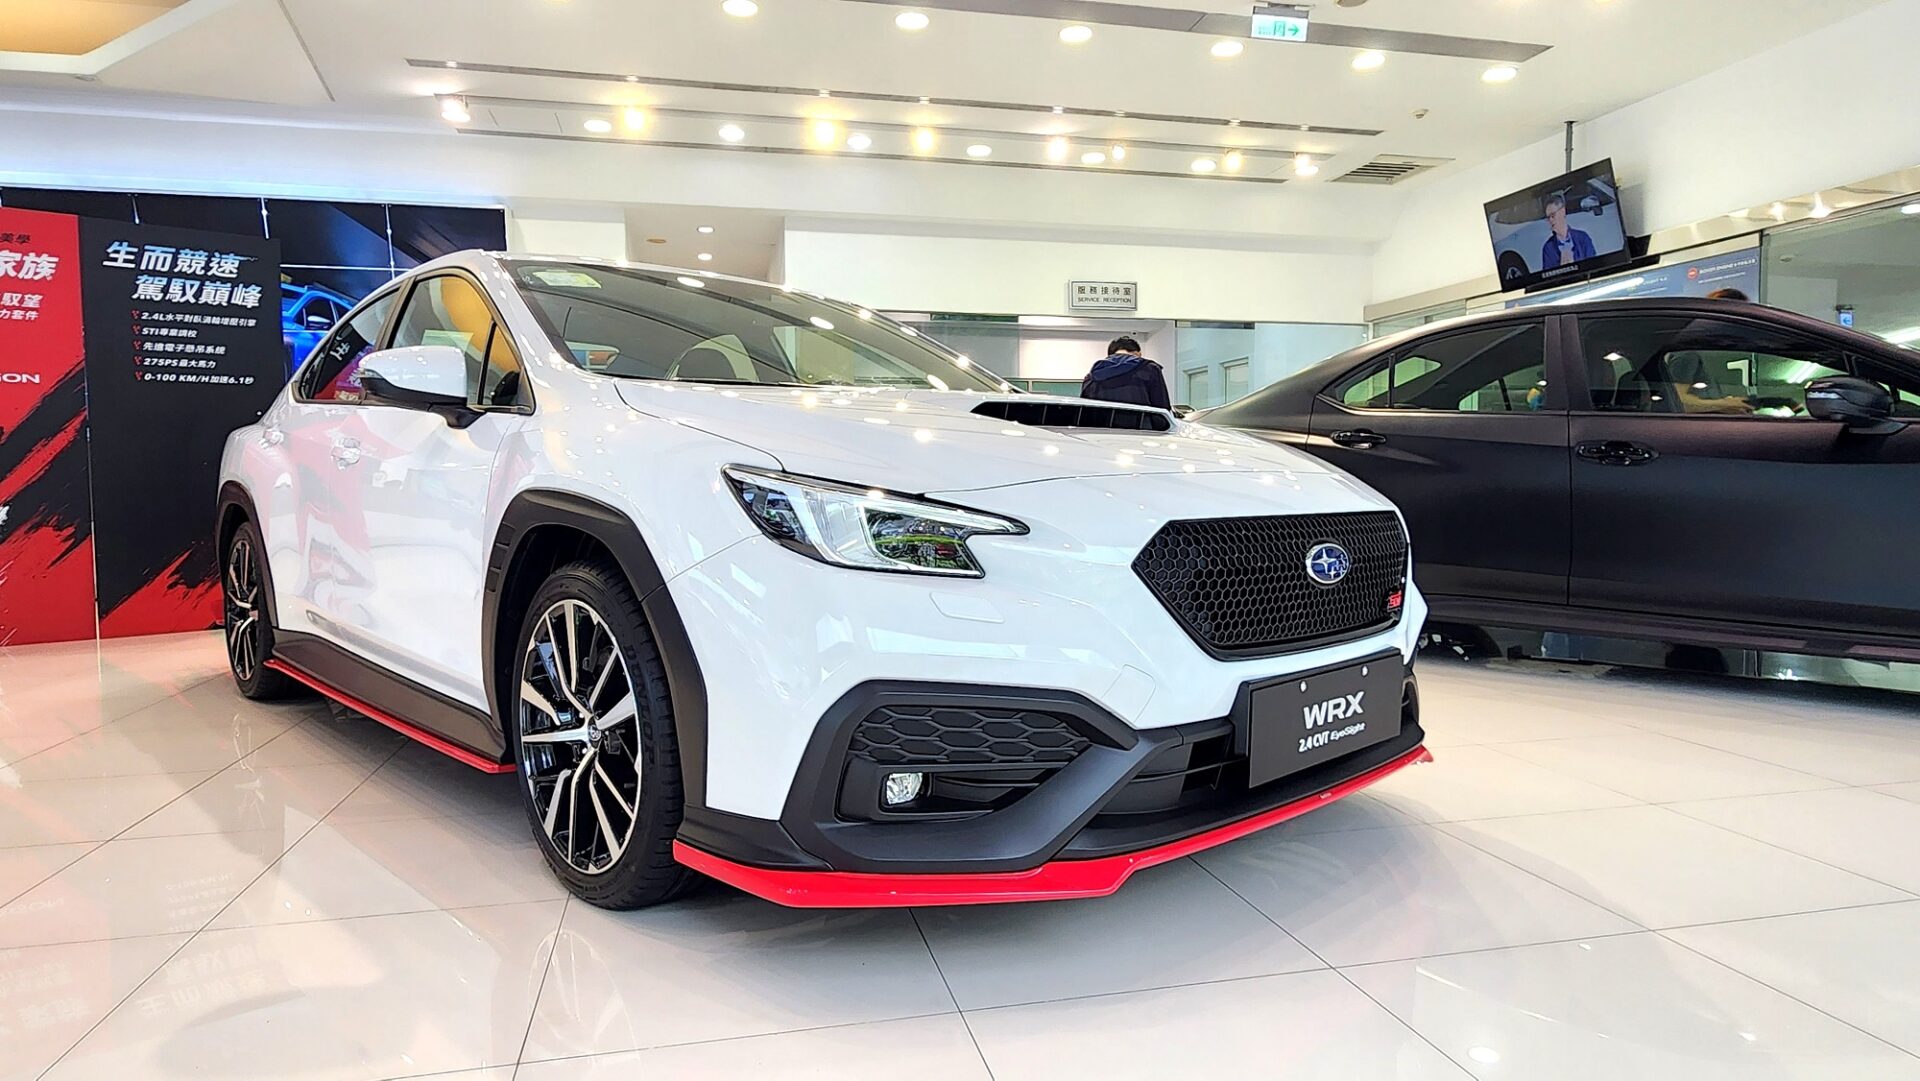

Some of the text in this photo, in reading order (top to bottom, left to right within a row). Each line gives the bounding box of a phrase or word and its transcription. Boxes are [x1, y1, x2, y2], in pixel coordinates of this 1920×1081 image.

[103, 241, 250, 278] 生而競速
[131, 275, 262, 308] 駕馭巔峰
[1077, 286, 1131, 295] 服務接待室
[0, 373, 40, 384] ON
[144, 373, 176, 382] 0-100
[1303, 691, 1365, 730] WRX
[1298, 722, 1366, 752] 2.4 CVT EyeSight
